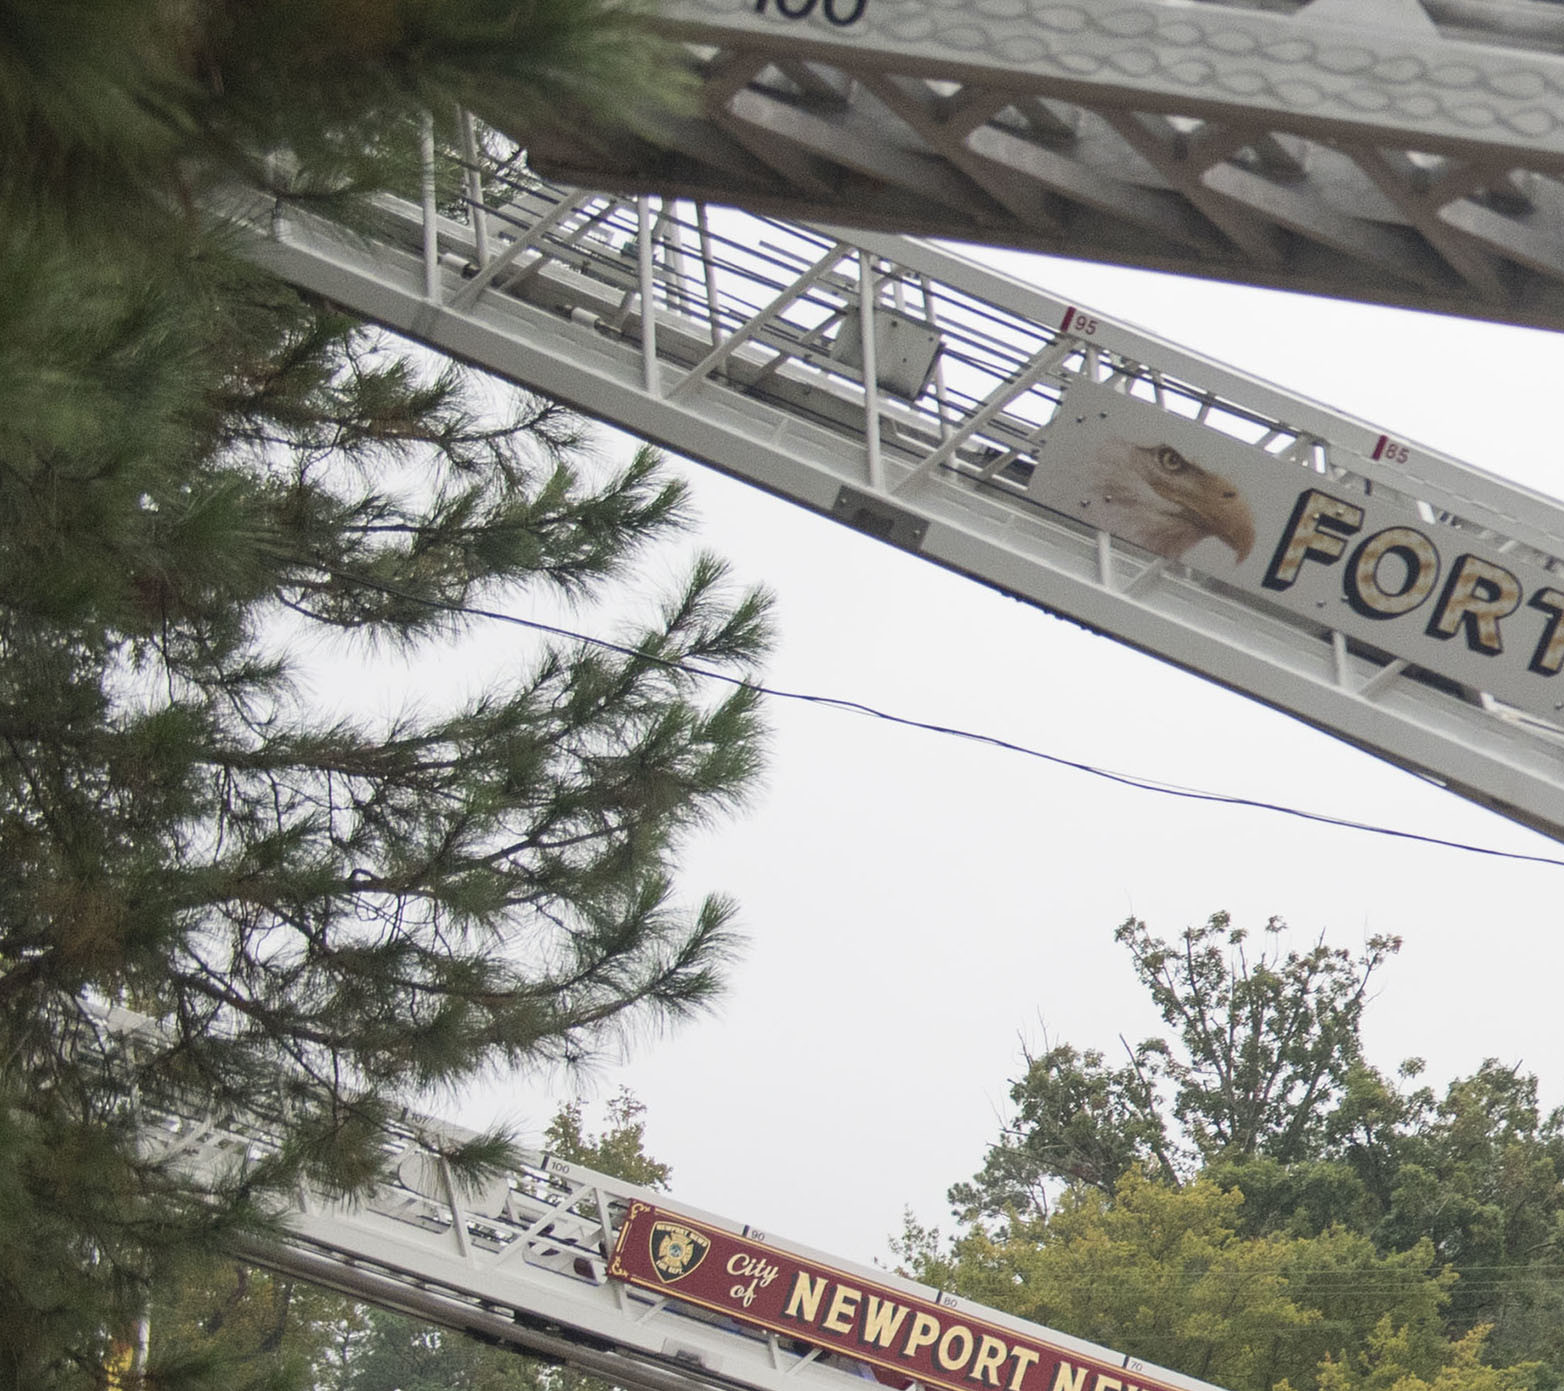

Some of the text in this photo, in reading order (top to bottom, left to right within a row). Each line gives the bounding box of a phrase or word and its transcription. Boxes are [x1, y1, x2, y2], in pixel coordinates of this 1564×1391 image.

[1072, 314, 1098, 336] 95
[551, 1161, 570, 1174] 100
[751, 1230, 765, 1241] 90
[726, 1253, 779, 1288] City
[729, 1281, 757, 1308] of
[943, 1295, 958, 1308] 80
[1130, 1360, 1144, 1372] 70
